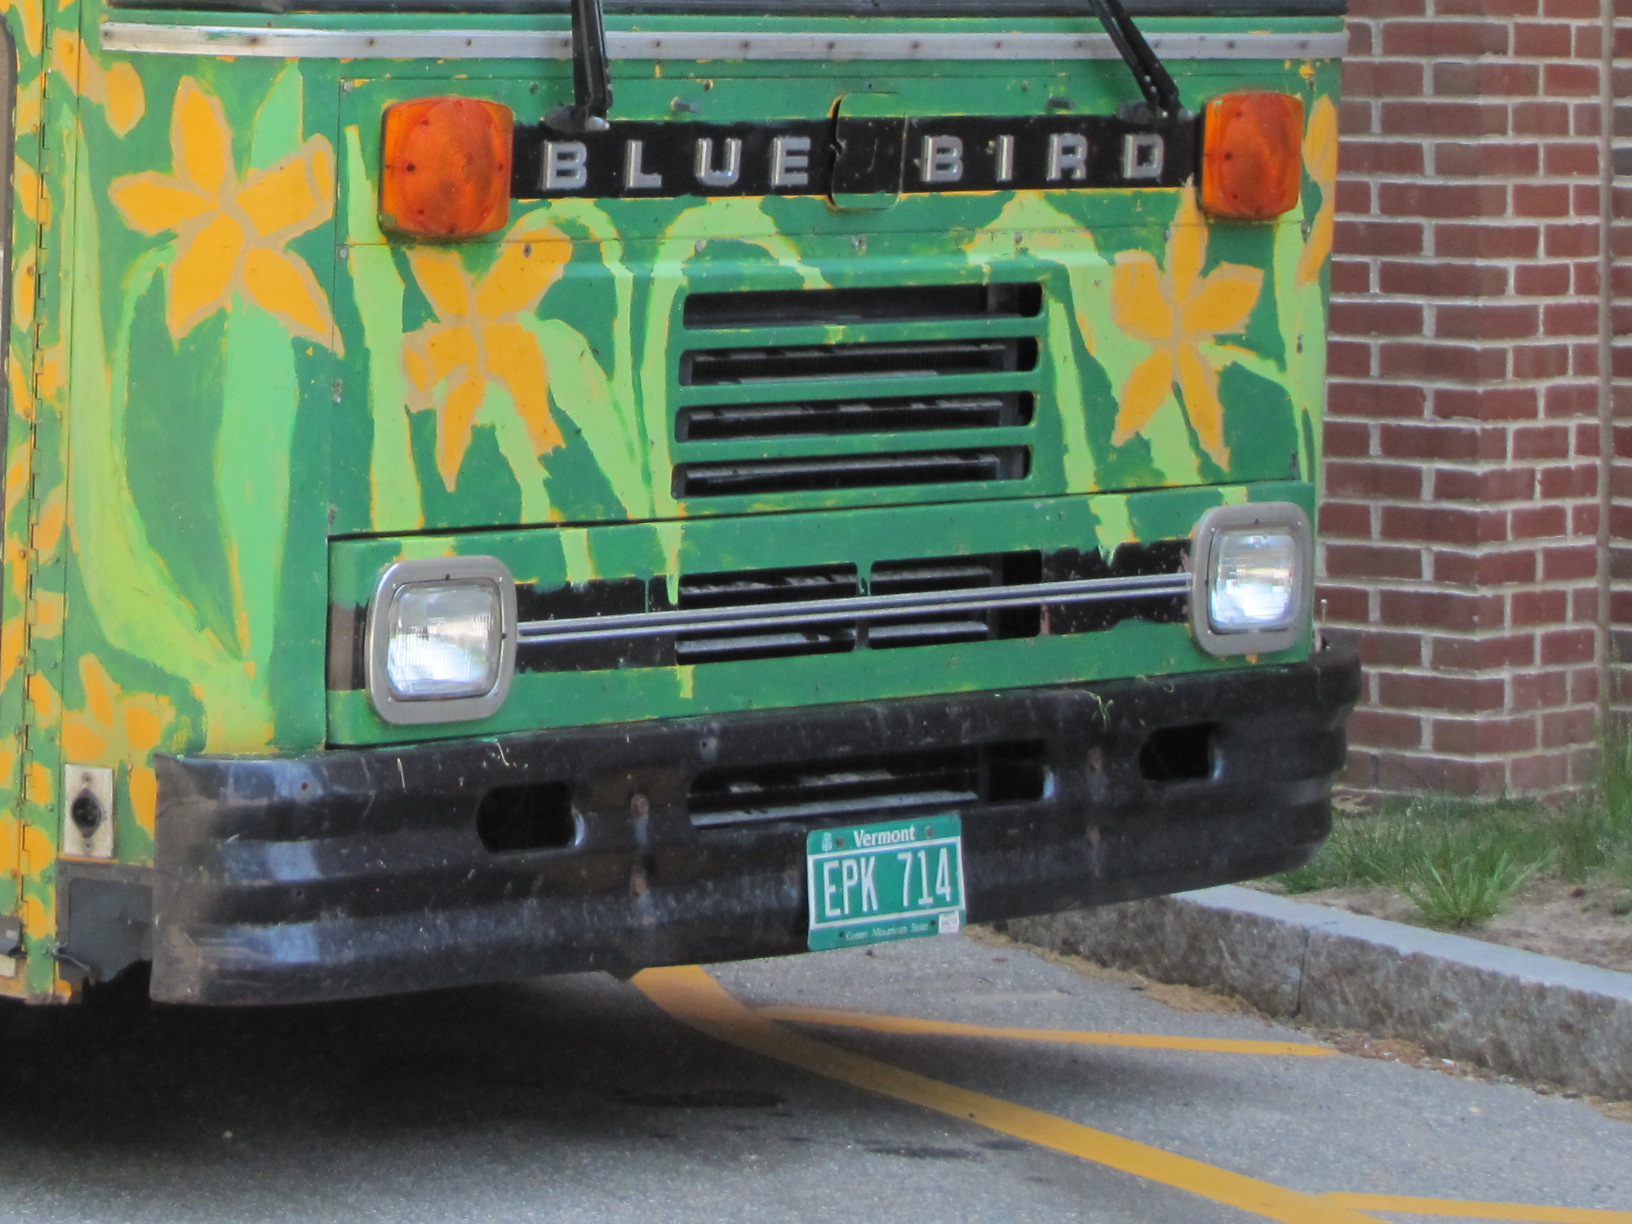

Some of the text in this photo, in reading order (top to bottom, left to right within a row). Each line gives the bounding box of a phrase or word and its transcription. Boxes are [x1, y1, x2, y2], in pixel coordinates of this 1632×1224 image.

[541, 132, 1164, 191] BLUE BIRD
[853, 825, 917, 848] Vermont
[823, 847, 952, 919] EPK 714
